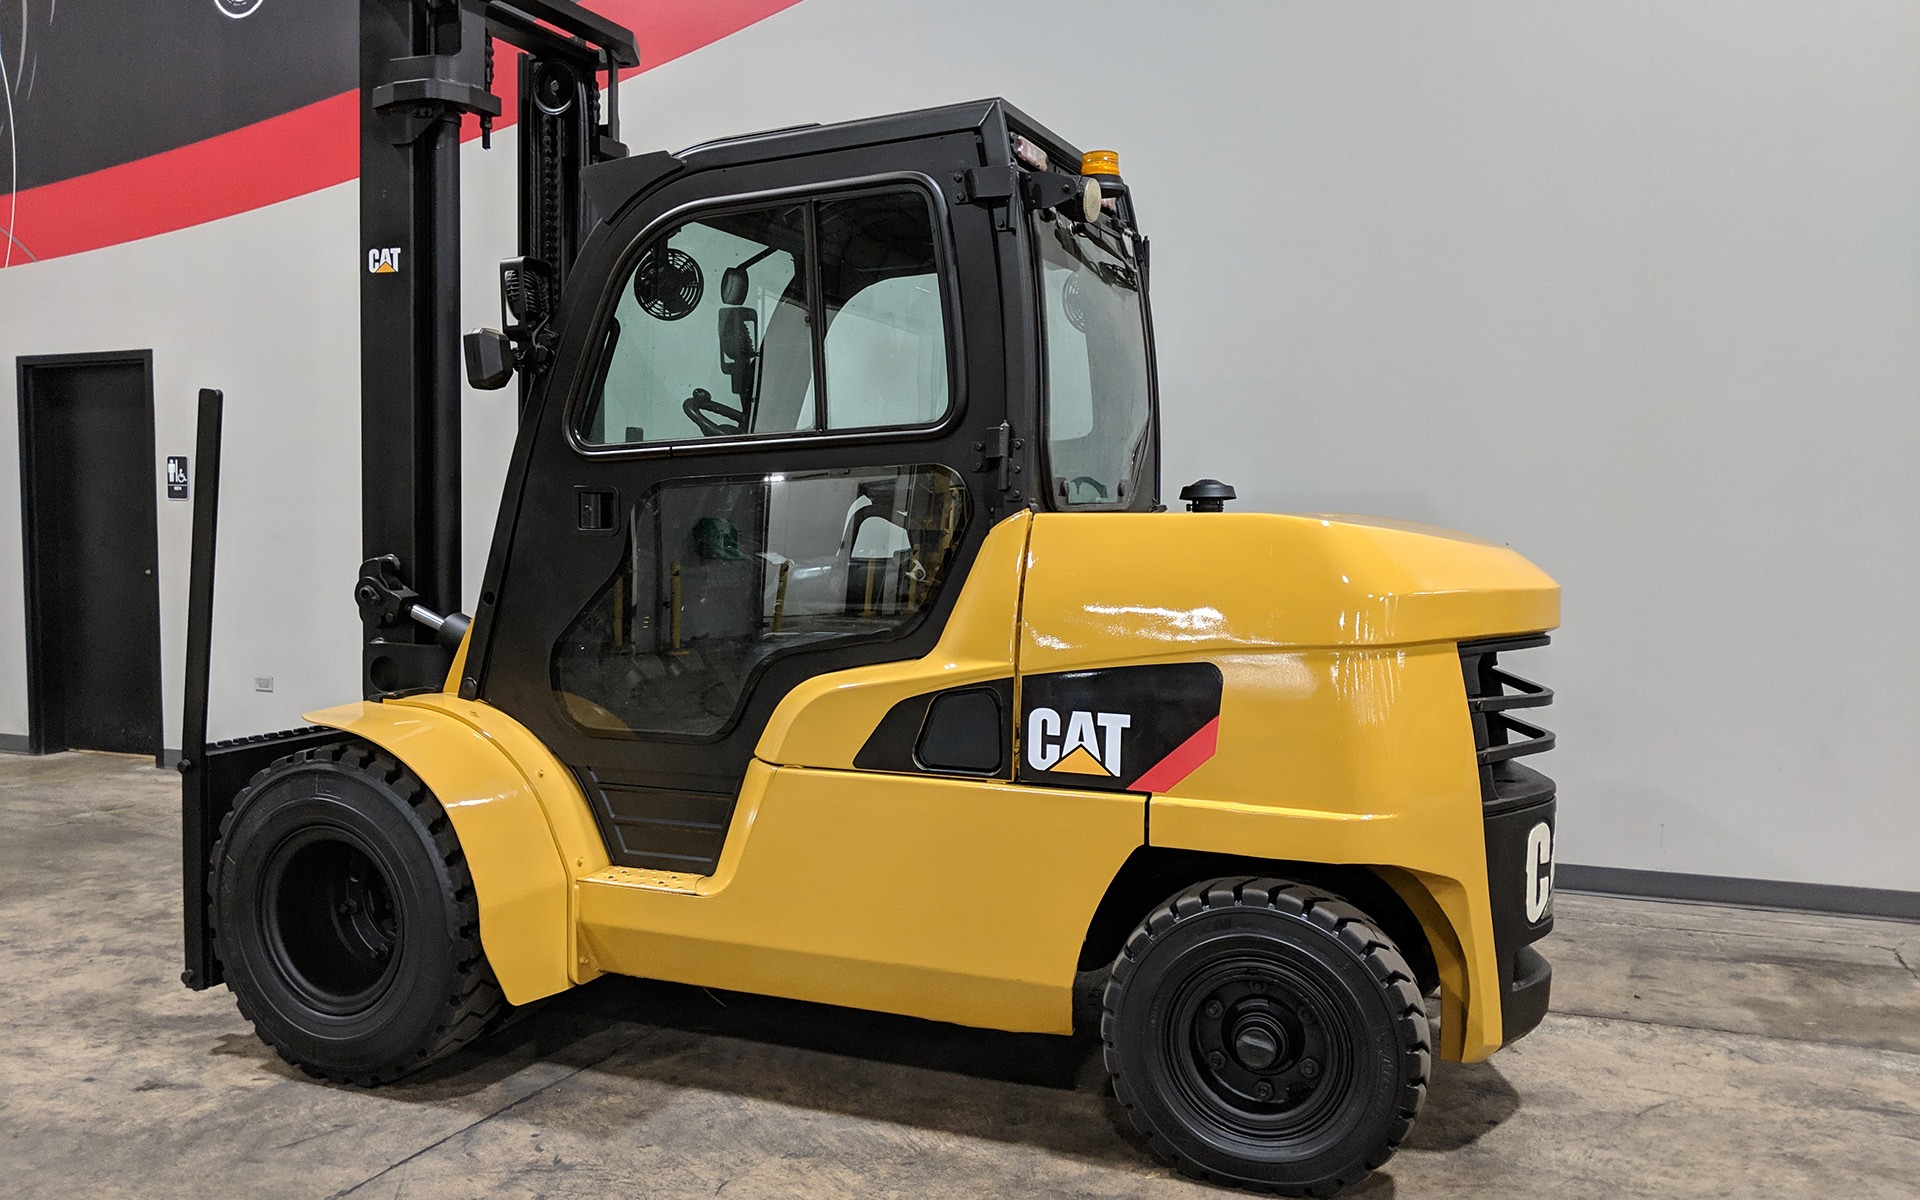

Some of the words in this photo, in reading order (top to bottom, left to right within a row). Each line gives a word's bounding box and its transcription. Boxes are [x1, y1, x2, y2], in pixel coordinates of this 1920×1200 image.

[368, 247, 401, 273] CAT
[1027, 707, 1131, 778] CAT
[1526, 822, 1555, 923] C
